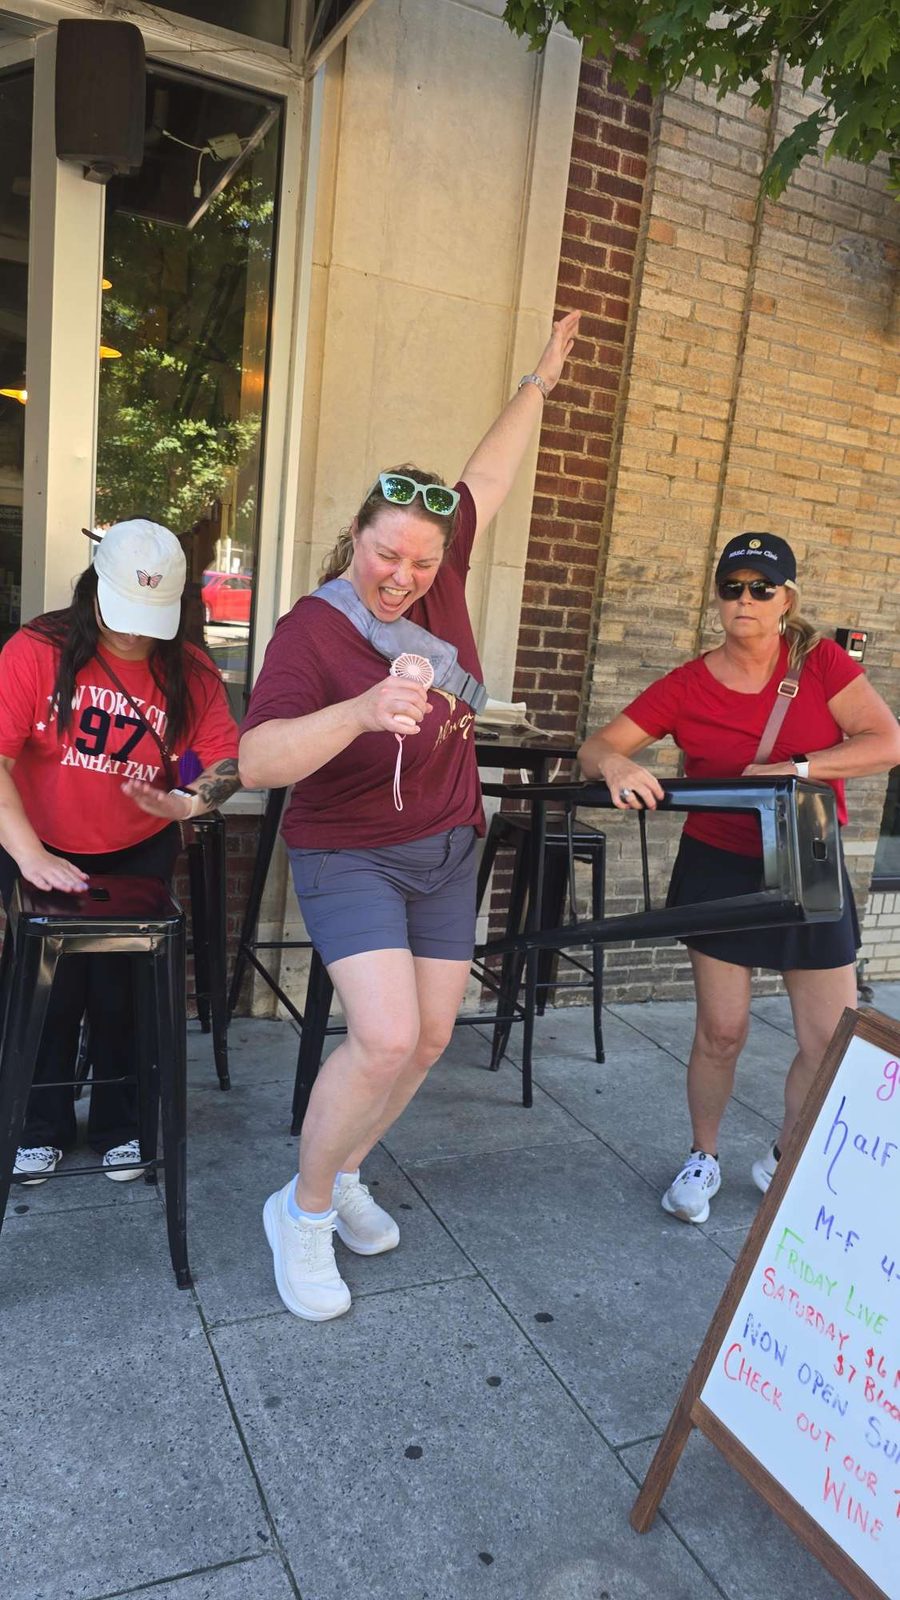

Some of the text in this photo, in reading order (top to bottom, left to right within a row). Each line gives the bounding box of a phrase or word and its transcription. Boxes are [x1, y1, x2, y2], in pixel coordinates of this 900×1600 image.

[75, 706, 148, 764] 97
[774, 1227, 838, 1297] FRIDAY
[815, 1205, 860, 1252] M-F
[762, 1266, 887, 1378] SATURDAY $6
[743, 1312, 788, 1368] NOW
[798, 1362, 849, 1417] OPEN
[833, 1353, 856, 1383] $7
[724, 1343, 878, 1497] CHECK OUT OUR
[823, 1467, 884, 1541] WINE
